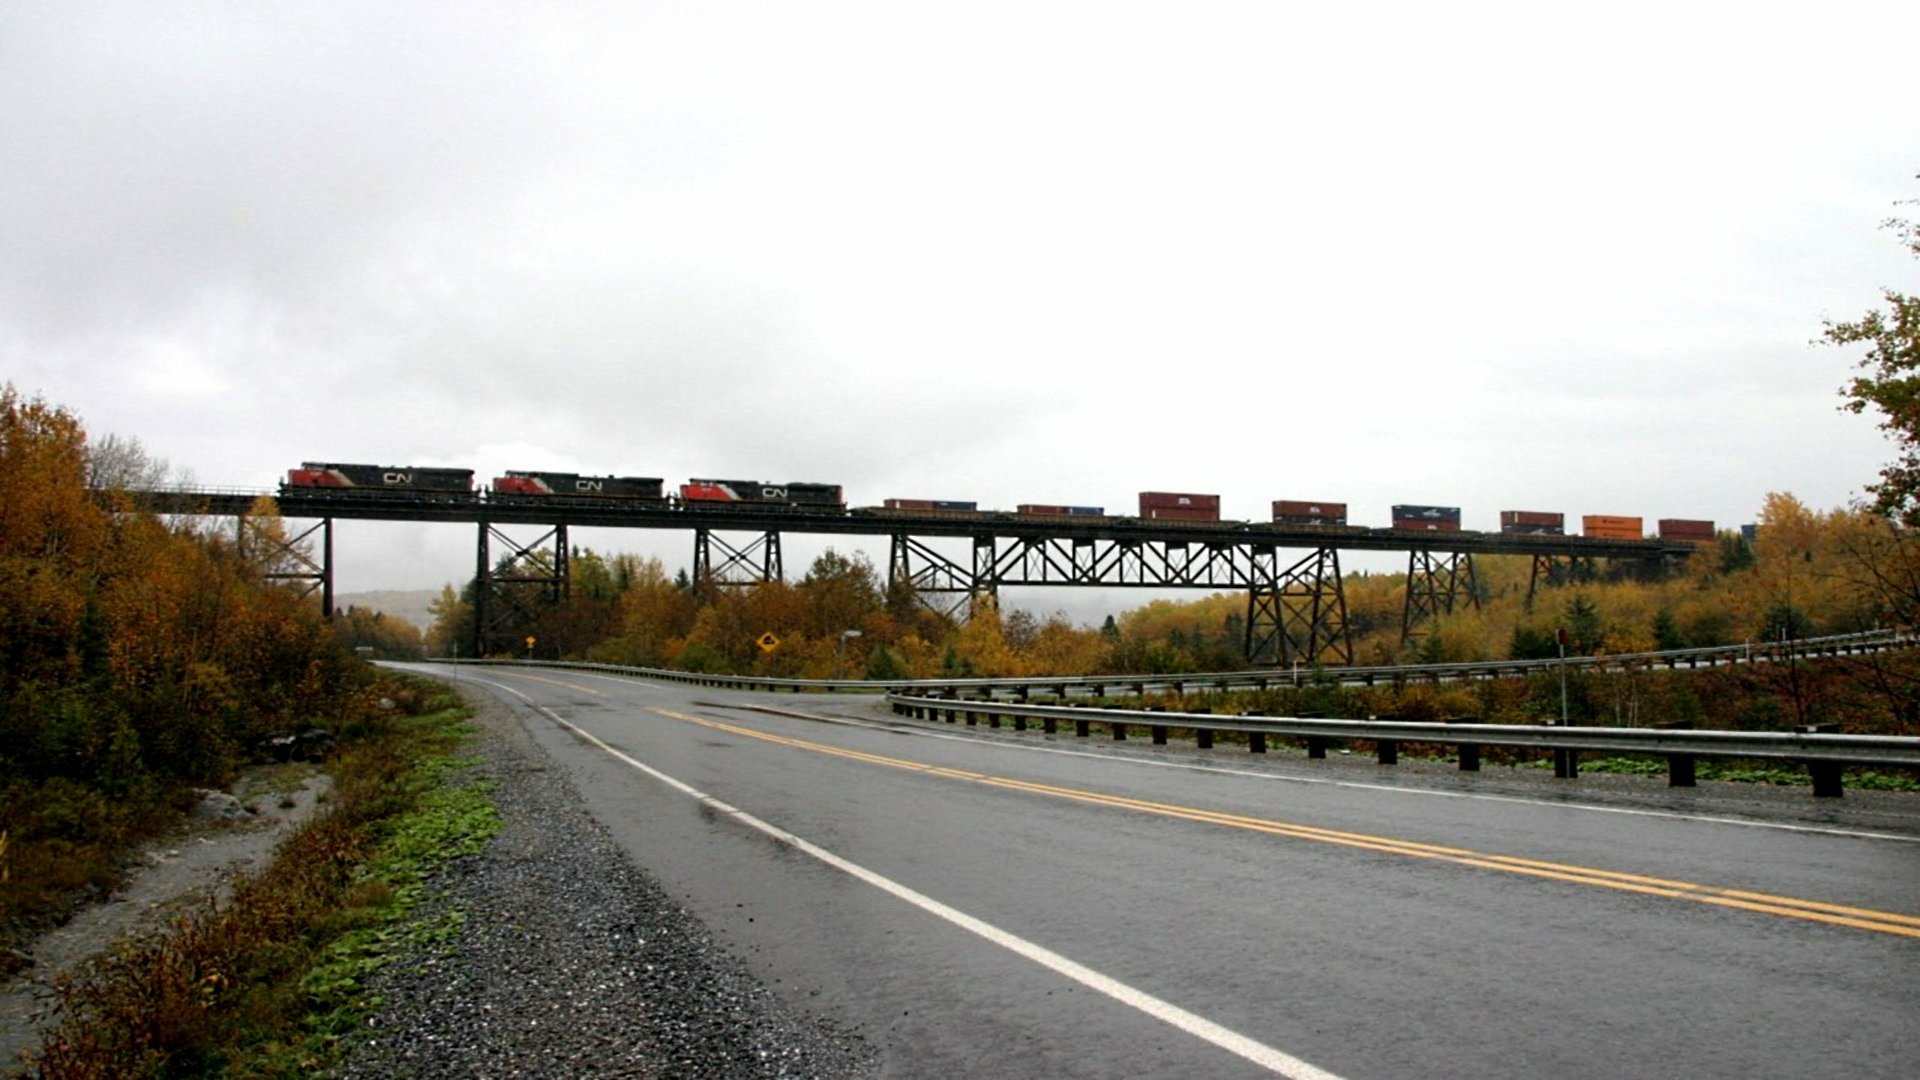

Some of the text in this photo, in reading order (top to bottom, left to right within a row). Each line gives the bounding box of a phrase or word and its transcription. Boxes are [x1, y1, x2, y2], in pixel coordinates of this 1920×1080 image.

[383, 473, 412, 483] CN
[575, 480, 602, 491] CN
[762, 487, 788, 498] CN
